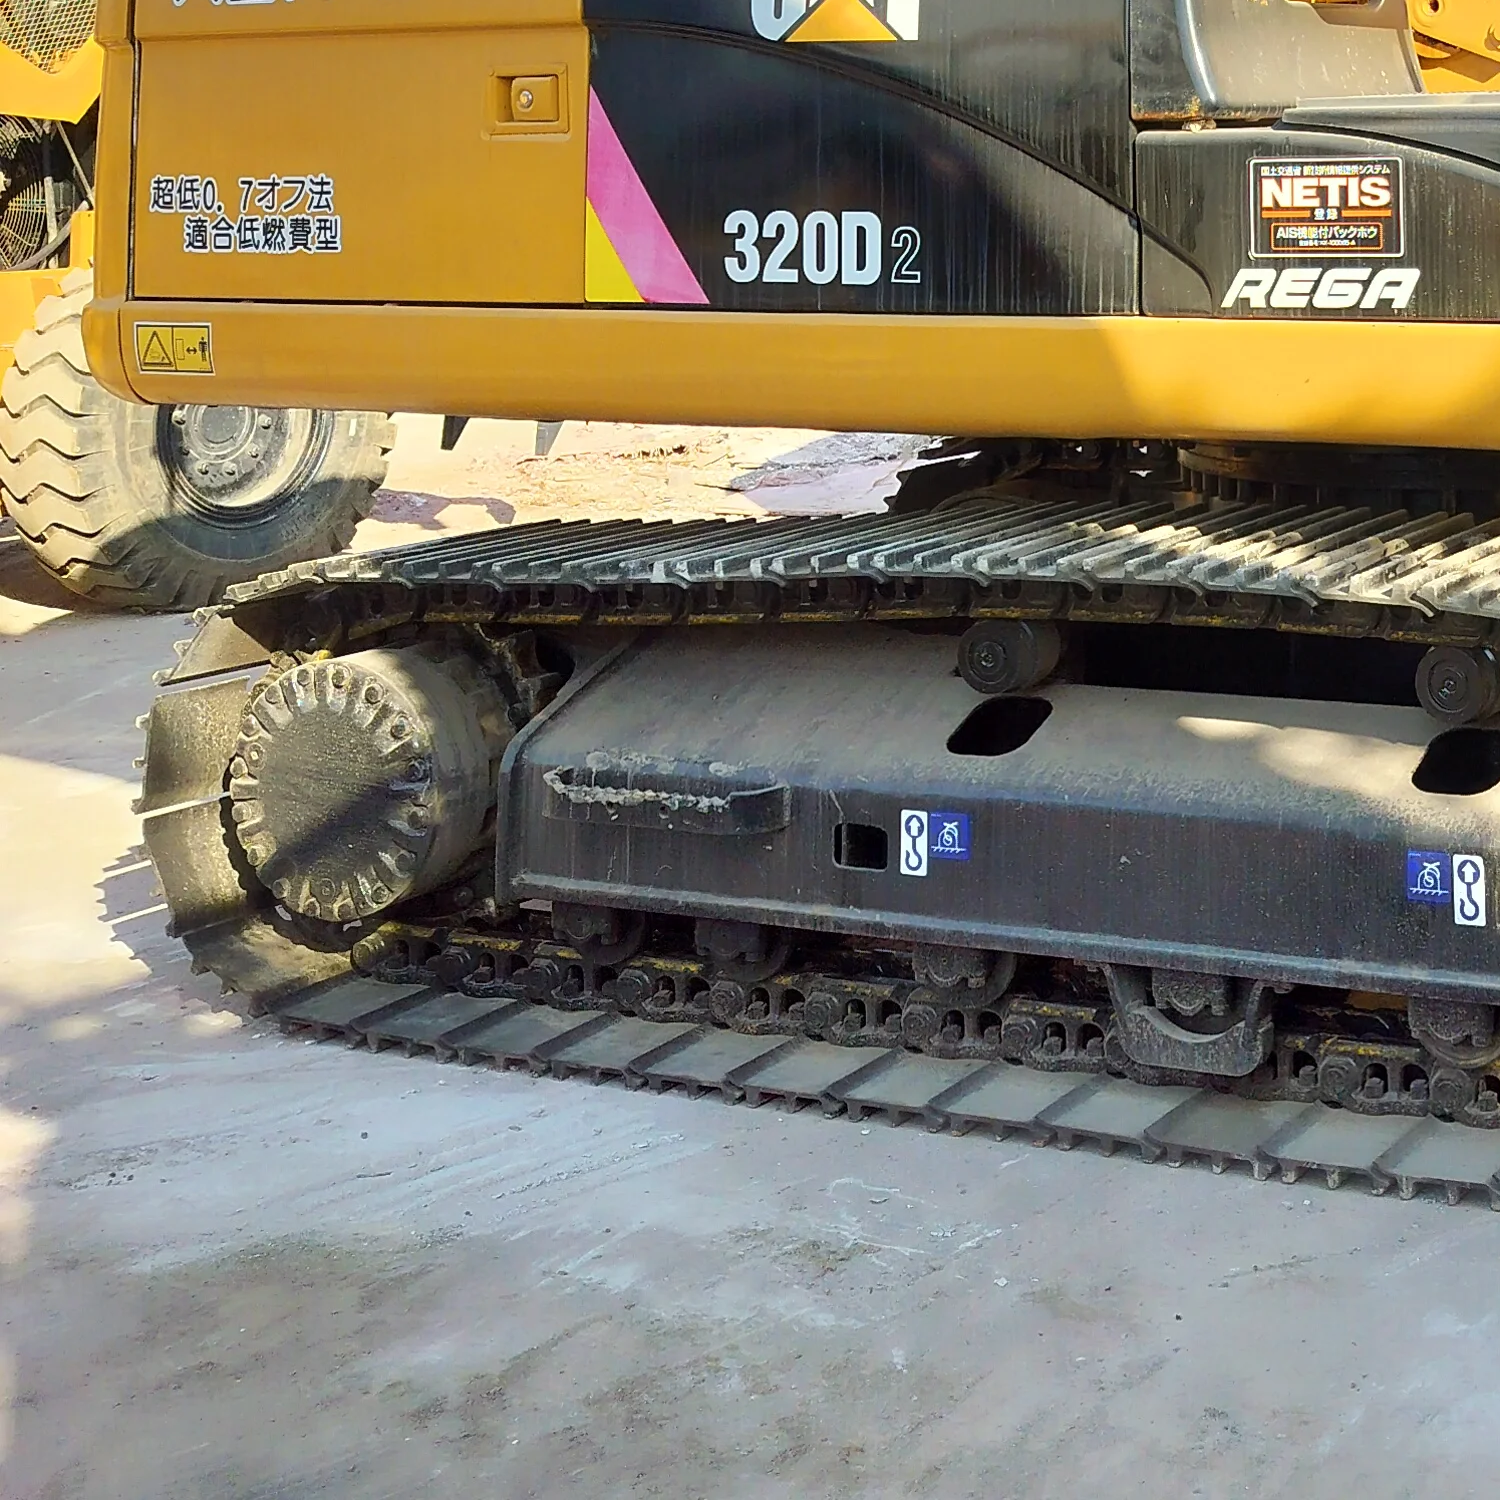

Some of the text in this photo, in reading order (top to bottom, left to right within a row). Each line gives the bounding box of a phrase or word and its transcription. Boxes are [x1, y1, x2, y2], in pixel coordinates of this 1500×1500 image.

[1261, 176, 1392, 208] NETIS
[184, 214, 342, 254] 適合低燃費型
[723, 210, 882, 285] 320D
[1220, 266, 1421, 309] REGA
